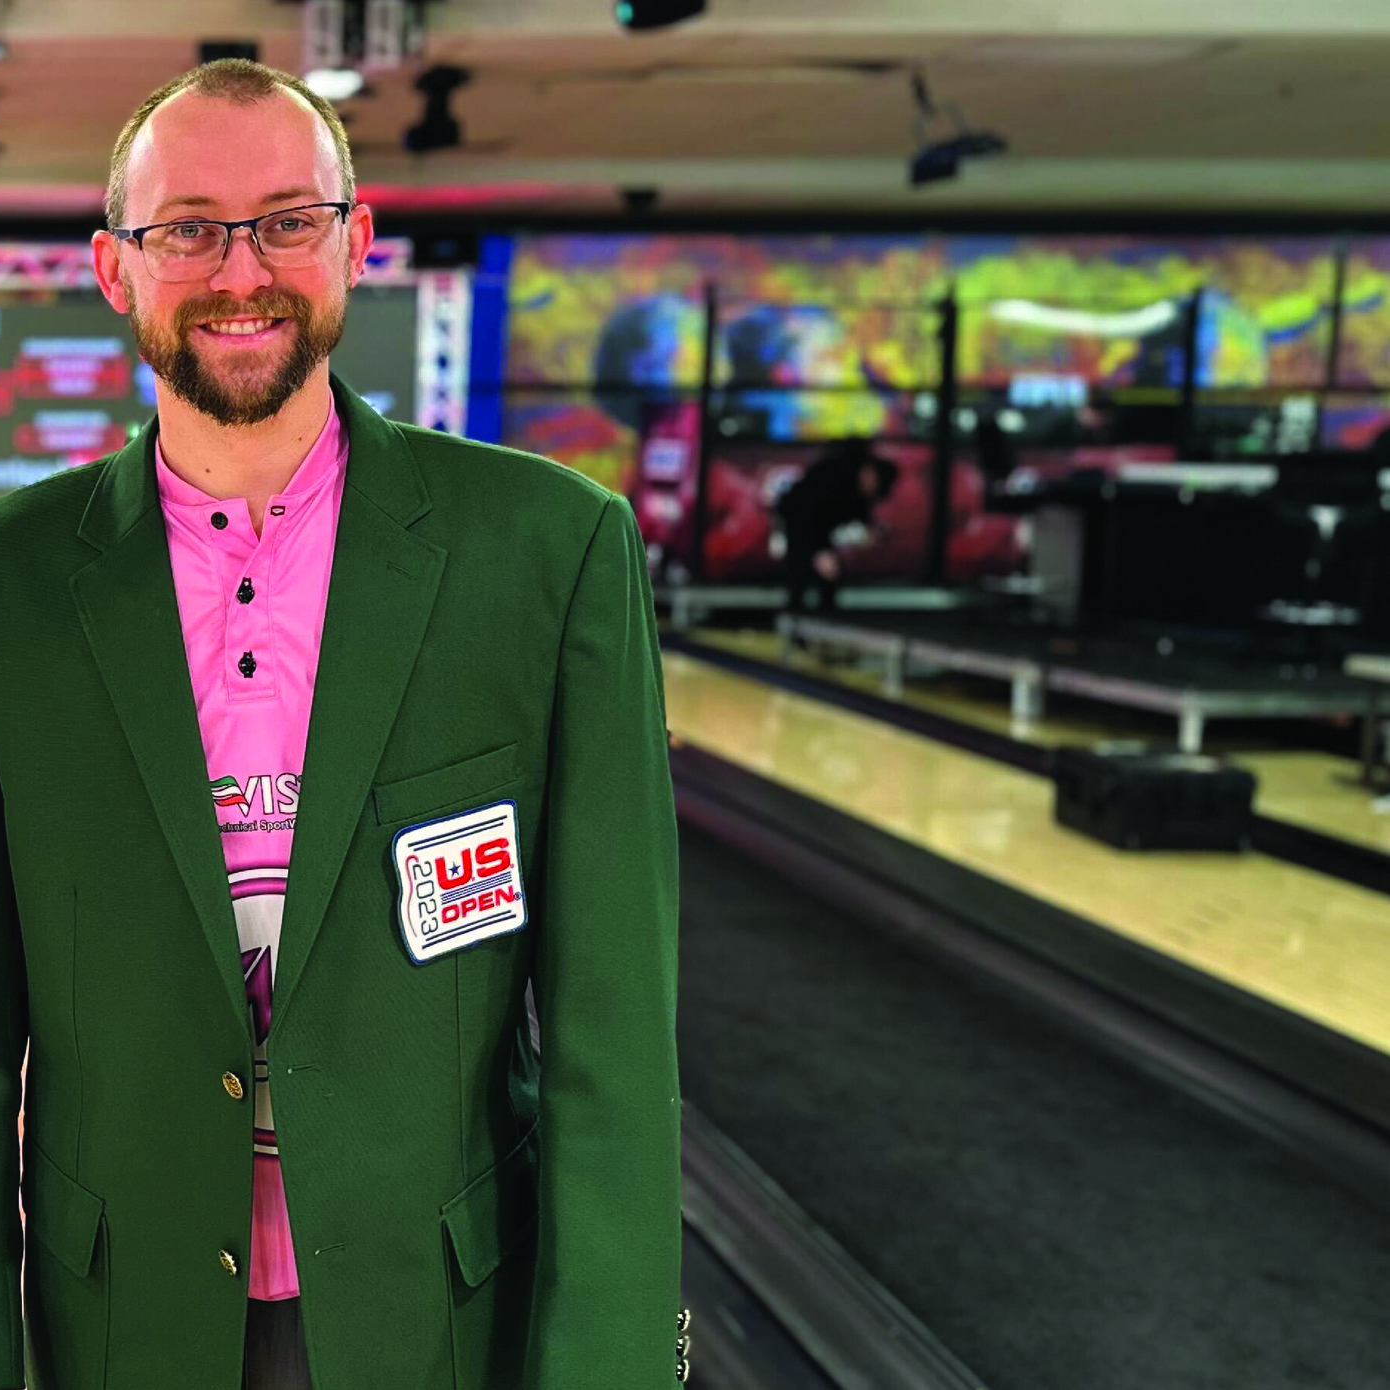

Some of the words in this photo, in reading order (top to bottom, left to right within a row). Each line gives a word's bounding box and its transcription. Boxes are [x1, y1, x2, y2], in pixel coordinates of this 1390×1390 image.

[235, 772, 302, 818] VIS
[219, 820, 258, 833] chnical
[413, 861, 438, 936] 2023
